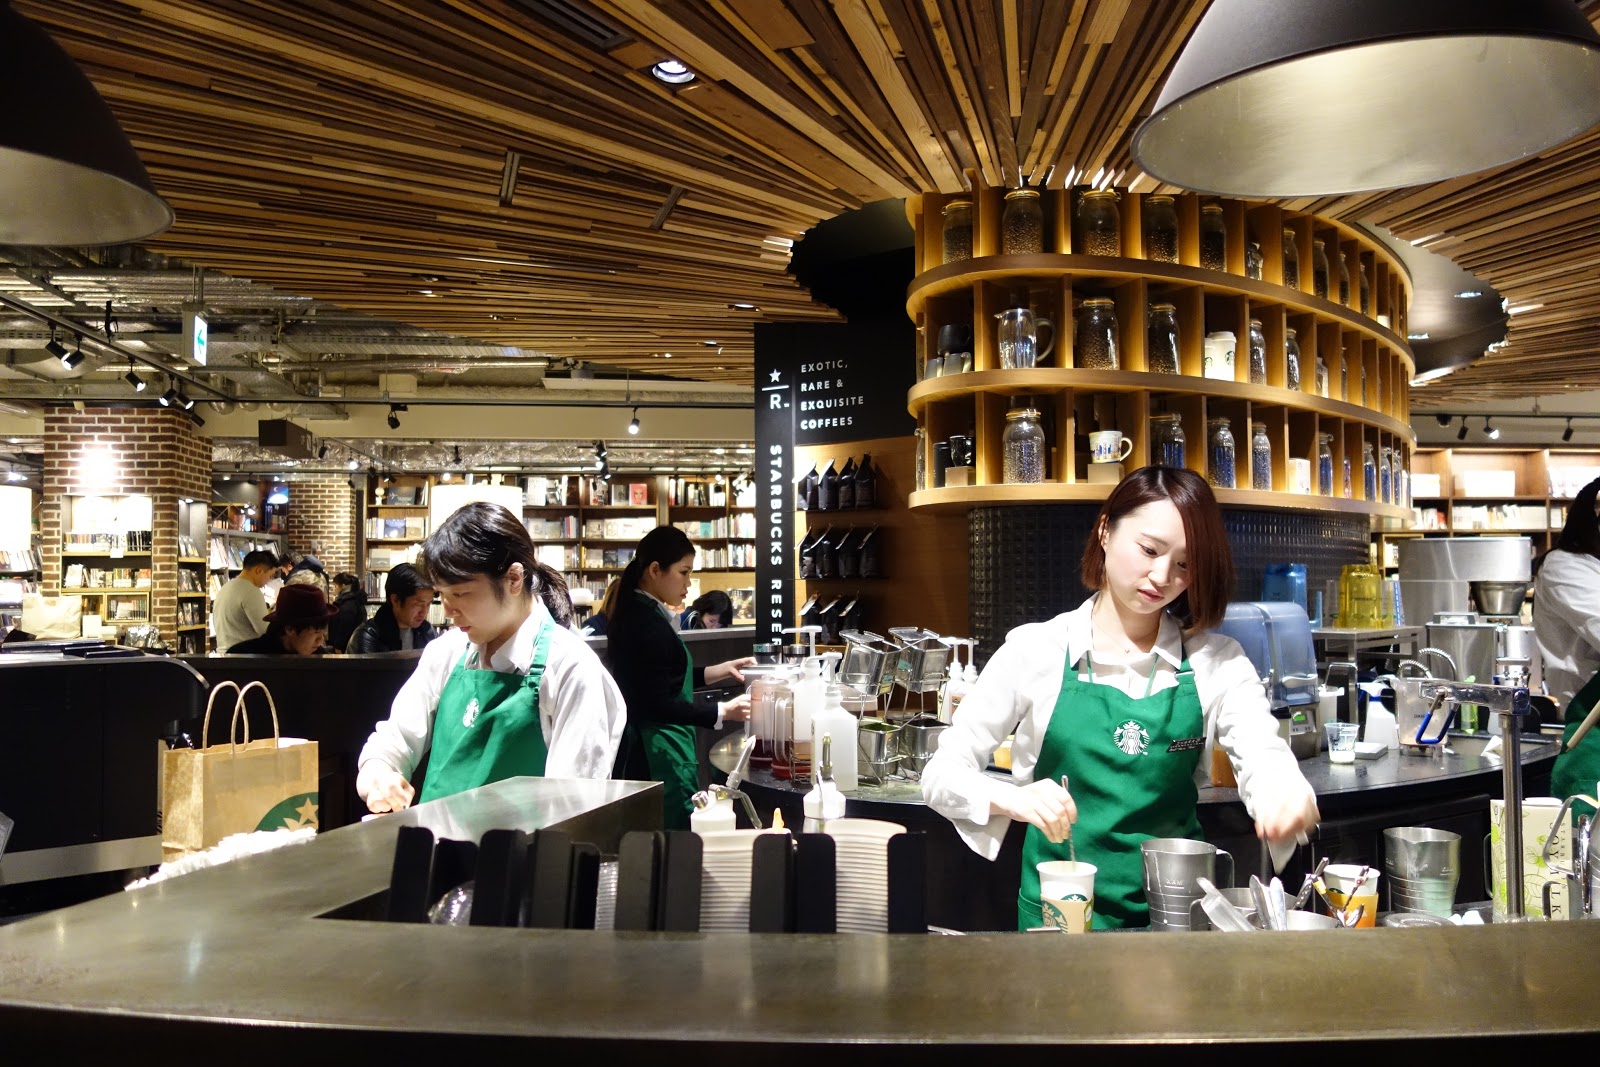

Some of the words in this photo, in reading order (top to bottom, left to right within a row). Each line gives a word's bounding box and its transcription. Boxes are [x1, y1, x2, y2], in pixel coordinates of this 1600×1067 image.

[801, 359, 848, 373] EXOTIC,
[801, 380, 830, 392] RARE
[836, 378, 844, 388] &
[800, 395, 864, 411] EXQUISITE
[800, 416, 853, 430] COFFEES
[770, 445, 783, 566] STARBUCKS
